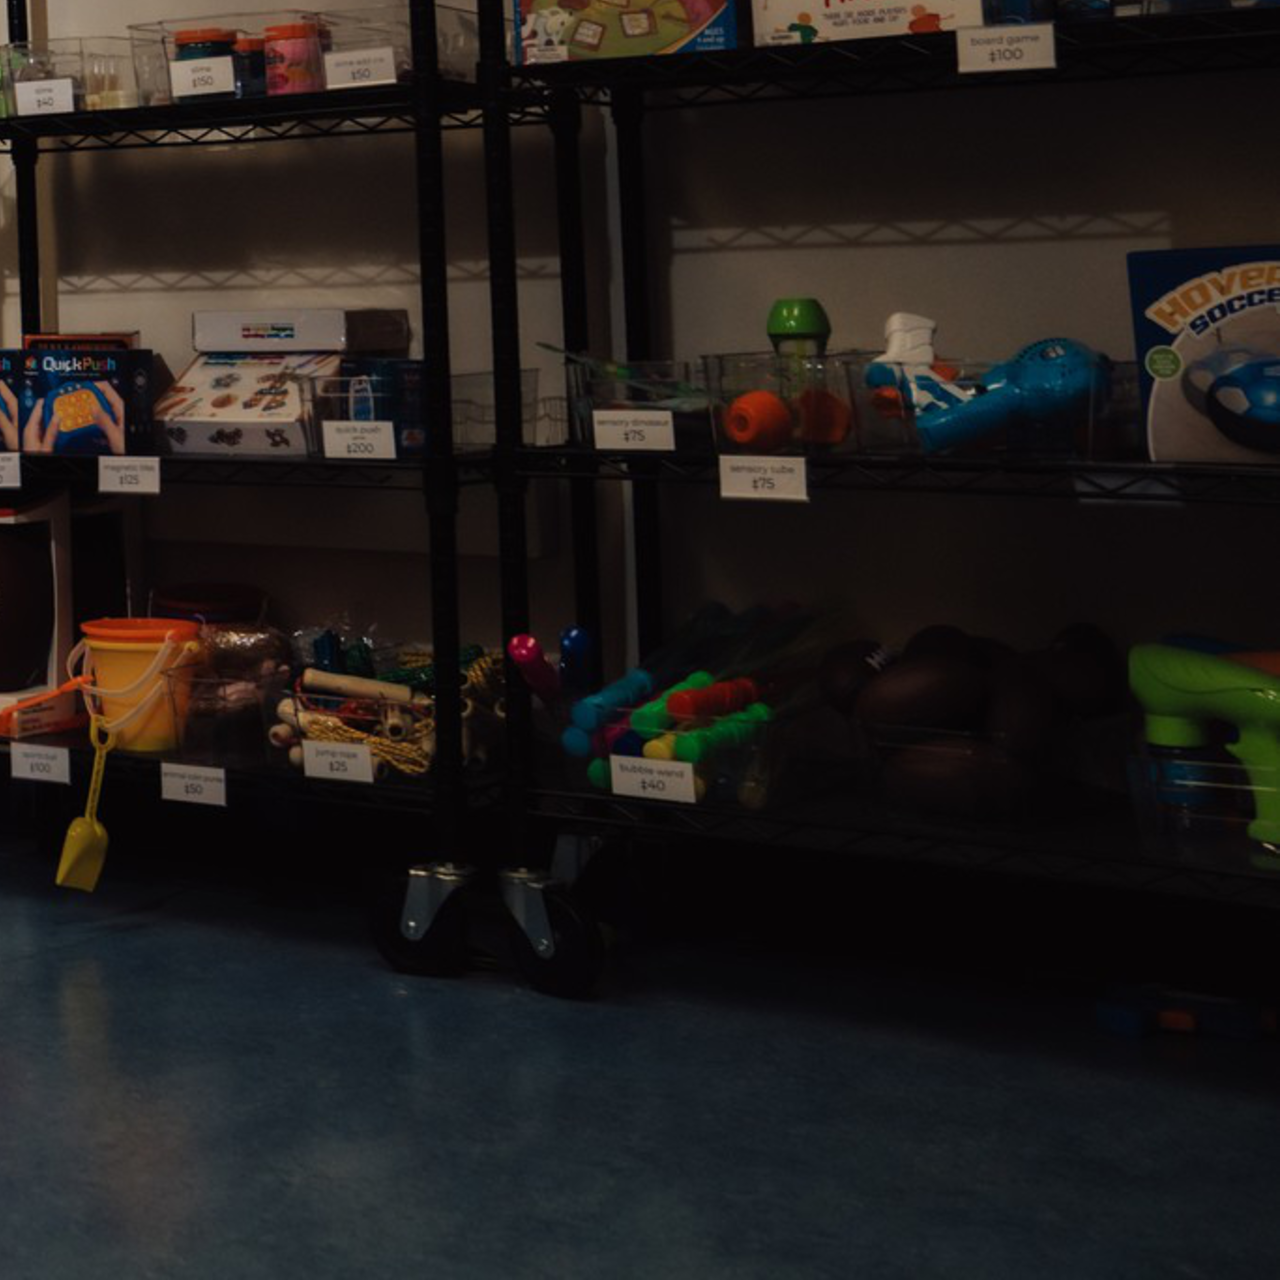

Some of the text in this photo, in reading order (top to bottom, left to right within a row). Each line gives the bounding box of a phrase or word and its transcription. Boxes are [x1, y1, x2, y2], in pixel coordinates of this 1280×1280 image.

[970, 34, 1041, 47] board game
[729, 465, 768, 476] sensory
[618, 762, 684, 779] bubble wand
